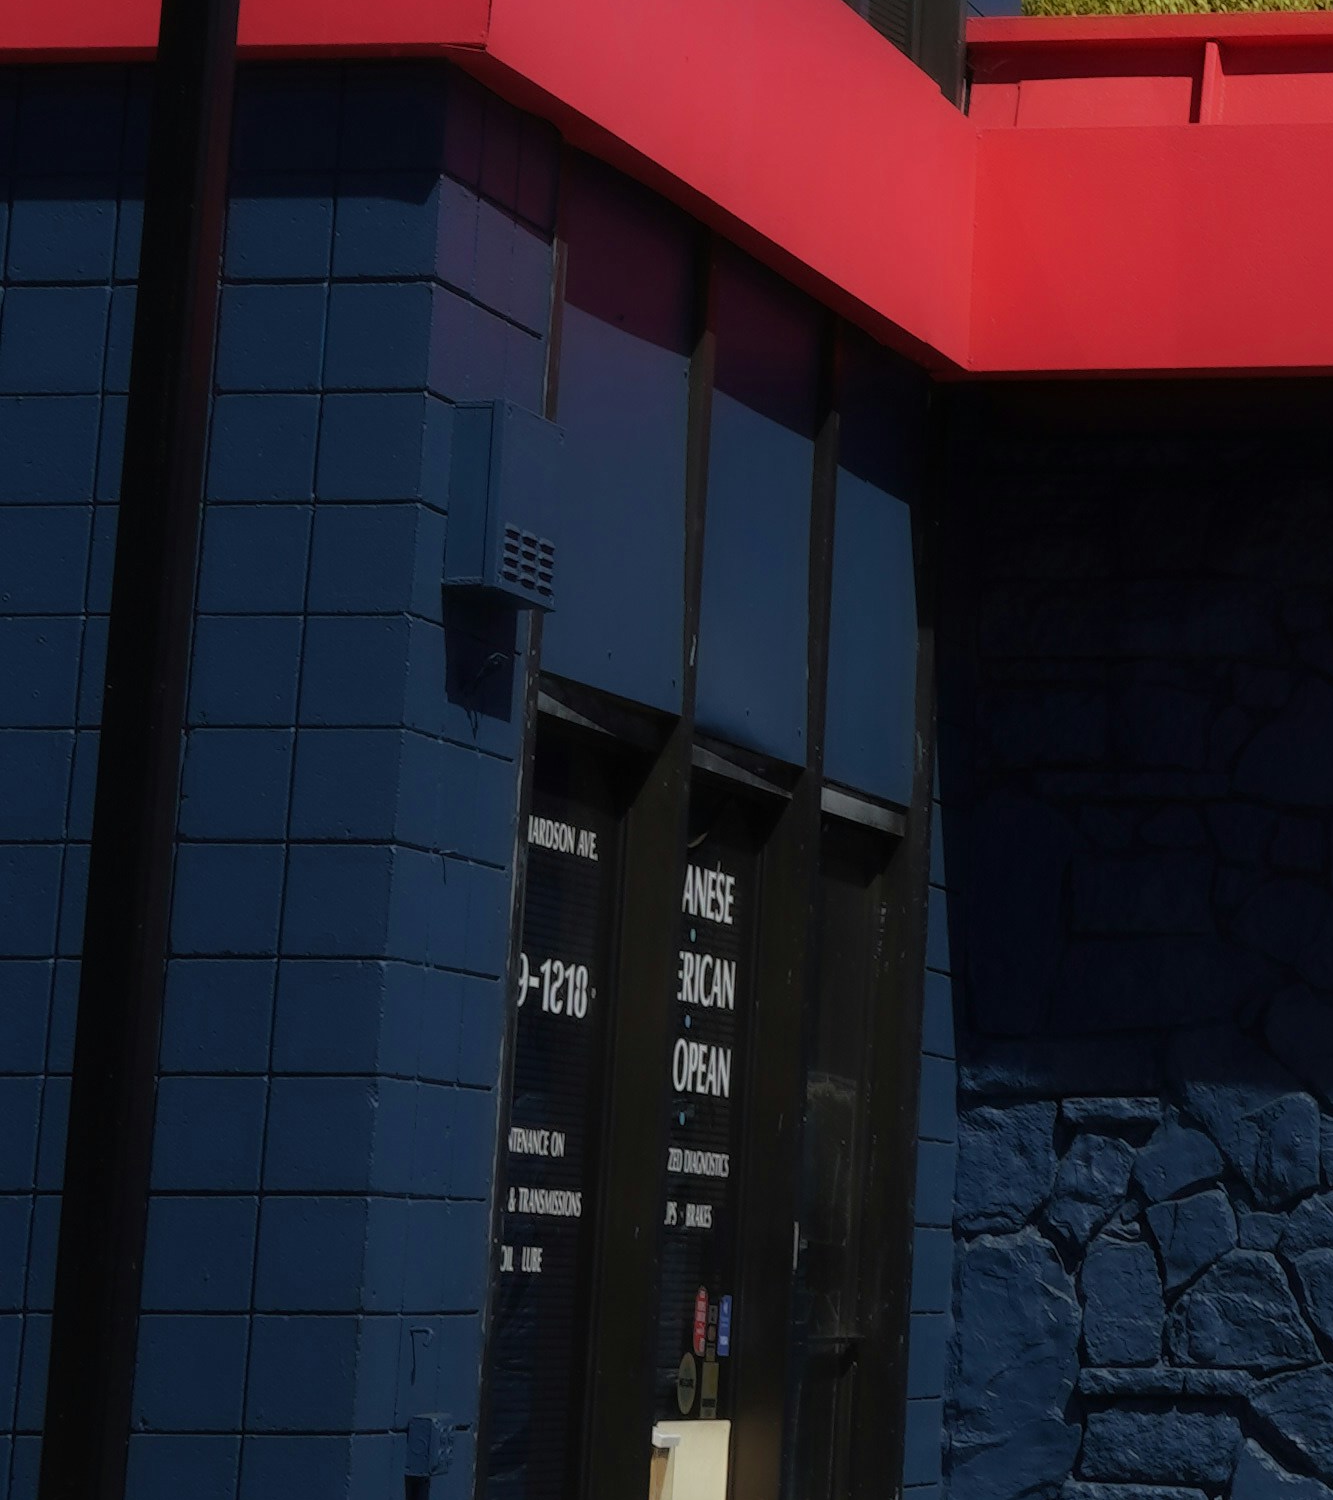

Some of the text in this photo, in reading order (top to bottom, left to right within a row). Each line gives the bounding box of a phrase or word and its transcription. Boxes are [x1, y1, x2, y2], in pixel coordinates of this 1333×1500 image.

[672, 1037, 732, 1098] OPEAN
[550, 1131, 566, 1158] ON
[683, 1149, 730, 1178] DIAGNOSTICS
[518, 1186, 583, 1218] TRANSMISSIONS
[685, 1203, 713, 1229] BRAKES
[521, 1246, 543, 1273] LUBE
